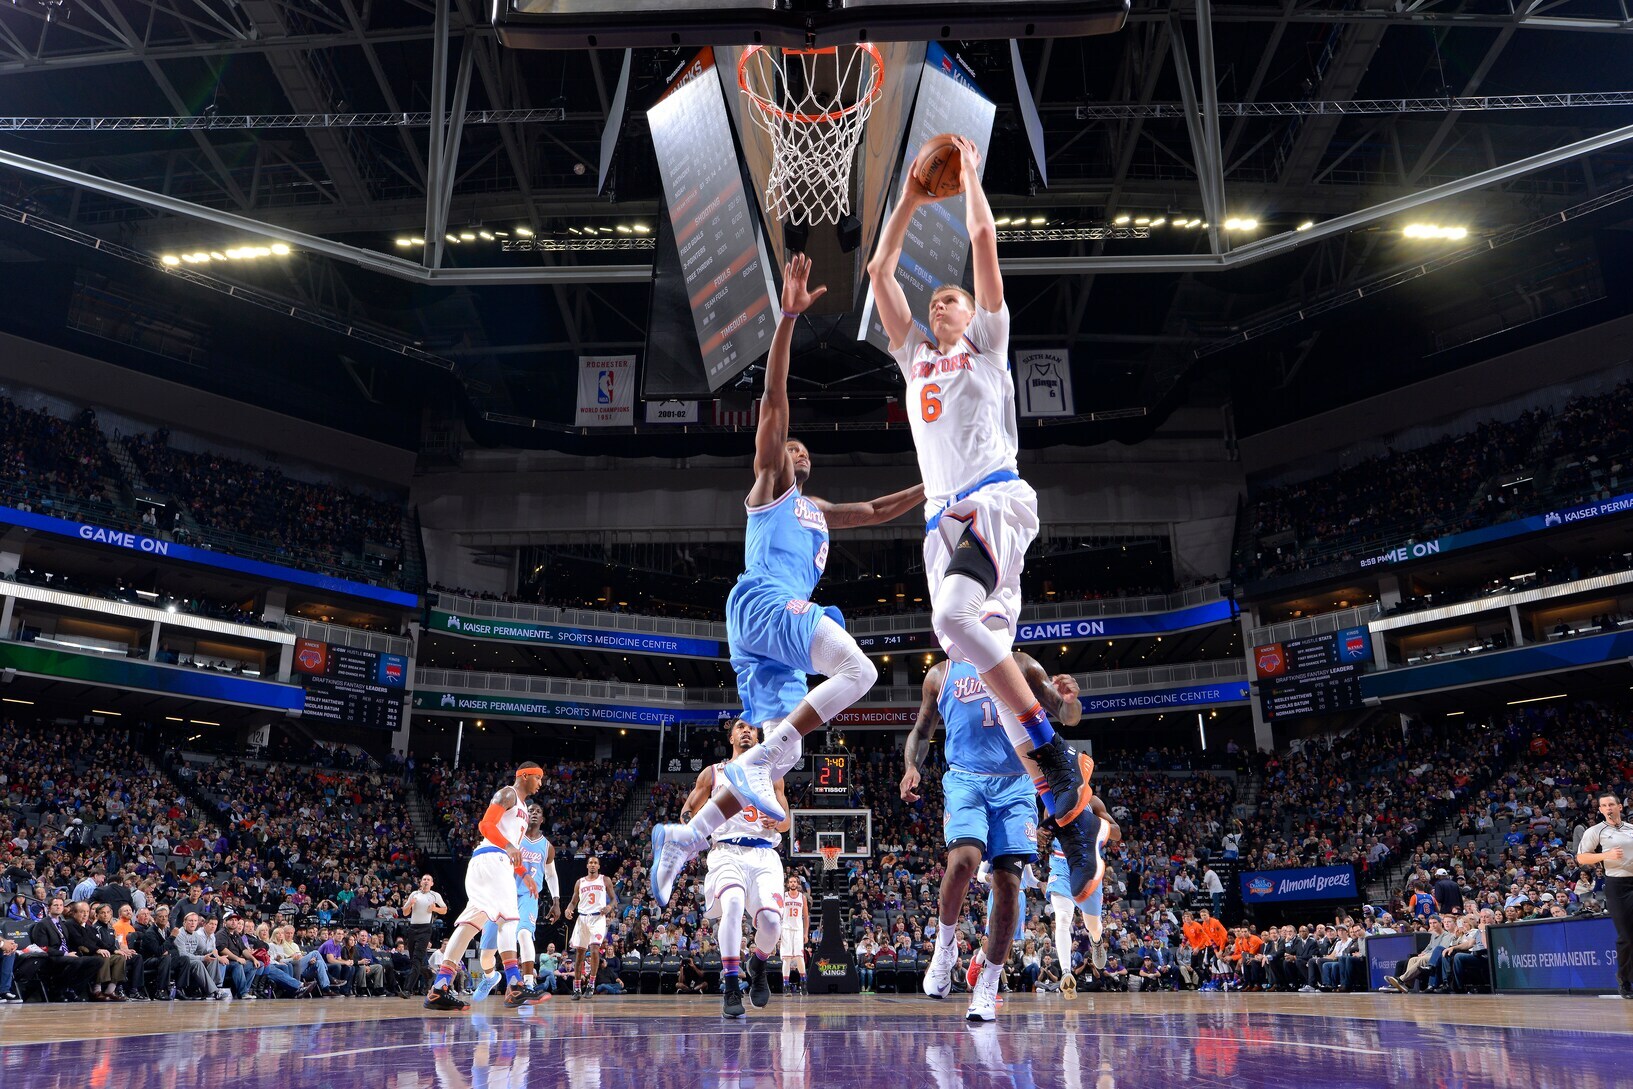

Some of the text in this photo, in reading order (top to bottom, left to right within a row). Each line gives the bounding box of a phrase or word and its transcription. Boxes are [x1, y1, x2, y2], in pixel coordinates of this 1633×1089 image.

[695, 197, 720, 226] SHOOTING
[680, 241, 692, 257] FIELD
[691, 231, 704, 248] GOALS
[683, 246, 707, 270] 3-POINTERS
[687, 270, 699, 284] FREE
[697, 257, 713, 275] THROWS
[714, 268, 732, 288] FOULS
[743, 261, 758, 278] BONUS
[914, 264, 933, 284] FOULS
[898, 266, 925, 292] TEAM FOULS
[705, 286, 729, 310] TEAM FOULS
[720, 313, 747, 339] TIMEOUTS
[722, 341, 733, 353] FULL
[586, 360, 628, 369] ROCHESTER
[935, 353, 973, 377] YORK
[1023, 354, 1063, 365] SIXTH MAN
[1050, 390, 1056, 398] 6
[920, 383, 943, 423] 6
[658, 411, 686, 419] 2001-02
[1565, 507, 1598, 522] KAISER
[80, 525, 169, 555] GAME ON
[1413, 541, 1440, 557] ON
[463, 623, 491, 634] KAISER
[558, 632, 593, 643] SPORTS
[595, 636, 640, 647] MEDICINE
[642, 640, 678, 650] CENTER
[1020, 621, 1105, 640] GAME ON
[884, 636, 901, 644] 7:41
[1276, 665, 1354, 683] DRAFTKINGS FANTASY LEADERS
[312, 676, 388, 693] DRAFTKINGS FANTASY LEADERS
[322, 698, 345, 706] MATTHEWS
[1090, 690, 1220, 710] SPORTS MEDICINE CENTER
[1290, 693, 1313, 701] MATTHEWS
[459, 699, 487, 710] KAISER
[555, 706, 590, 717] SPORTS
[592, 709, 637, 720] MEDICINE
[640, 712, 675, 722] CENTER
[862, 713, 907, 721] MEDICINE
[252, 731, 264, 744] 124
[825, 758, 845, 768] 7:40
[821, 768, 843, 785] 21
[1278, 873, 1350, 895] Almond Breeze
[589, 893, 596, 905] 3
[790, 908, 799, 917] 13
[1512, 954, 1538, 968] KAISER
